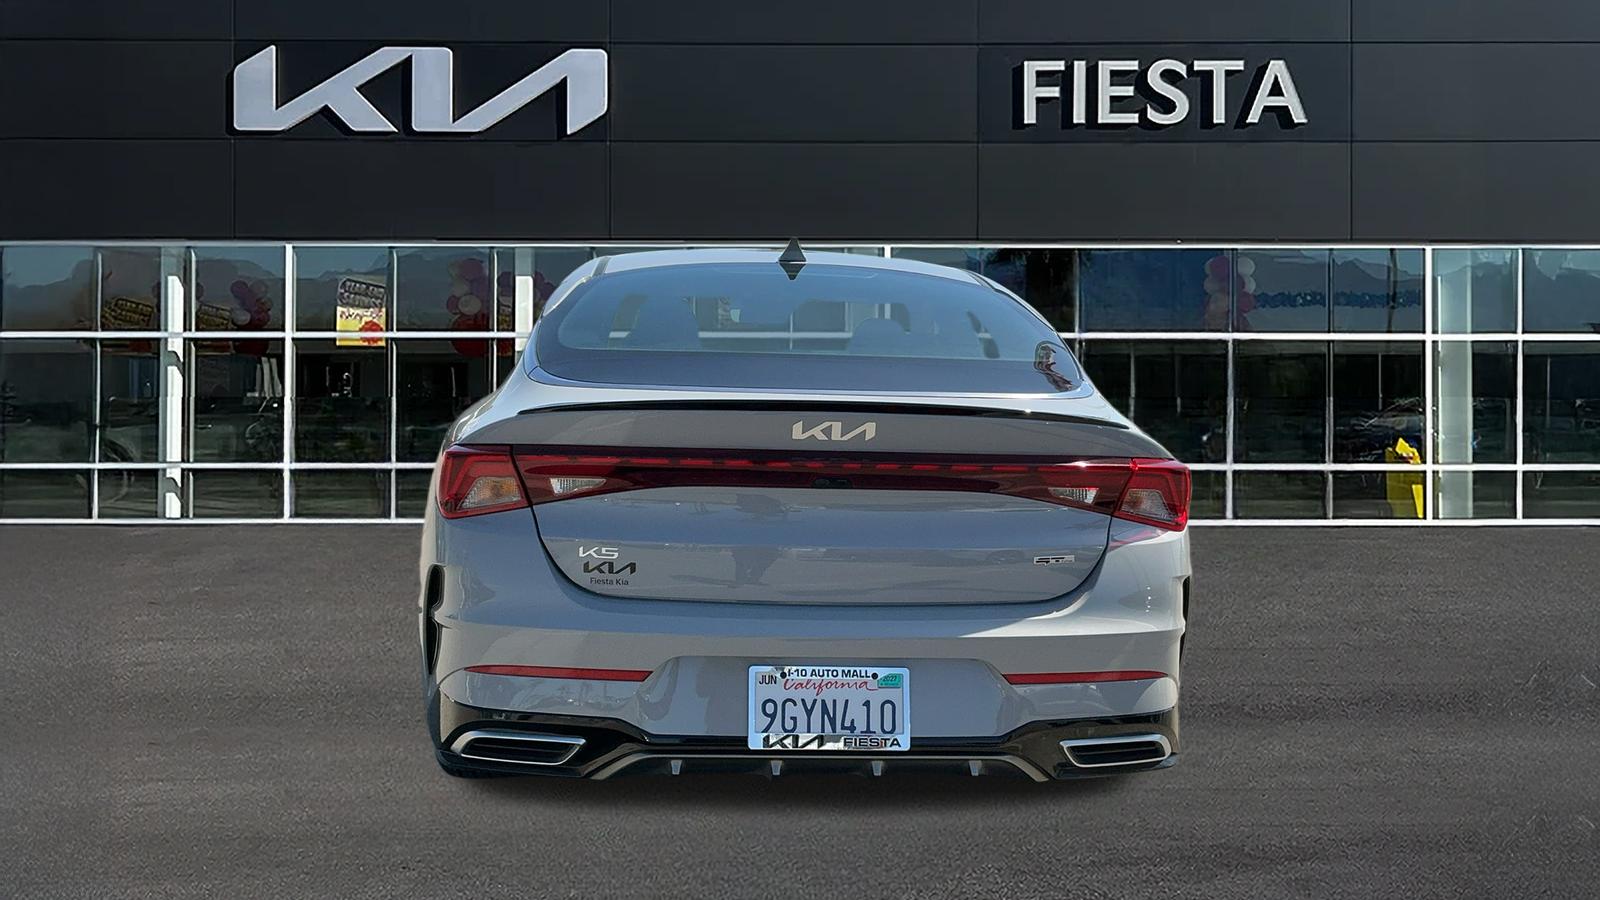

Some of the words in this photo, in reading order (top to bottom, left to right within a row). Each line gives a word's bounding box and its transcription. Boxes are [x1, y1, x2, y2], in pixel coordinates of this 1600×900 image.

[233, 45, 608, 135] KIA
[1022, 59, 1308, 125] FIESTA
[792, 420, 876, 441] KIA
[578, 546, 619, 559] K5
[583, 561, 637, 576] KIA
[589, 577, 614, 585] Fiesta
[615, 577, 629, 586] Kia
[758, 674, 777, 685] JUN
[787, 668, 808, 679] I-10
[810, 668, 839, 679] AUTO
[841, 669, 871, 680] MALL
[783, 678, 878, 696] California
[760, 698, 897, 735] 9GYN410
[762, 734, 826, 749] KIA
[843, 737, 902, 749] FIESTA
